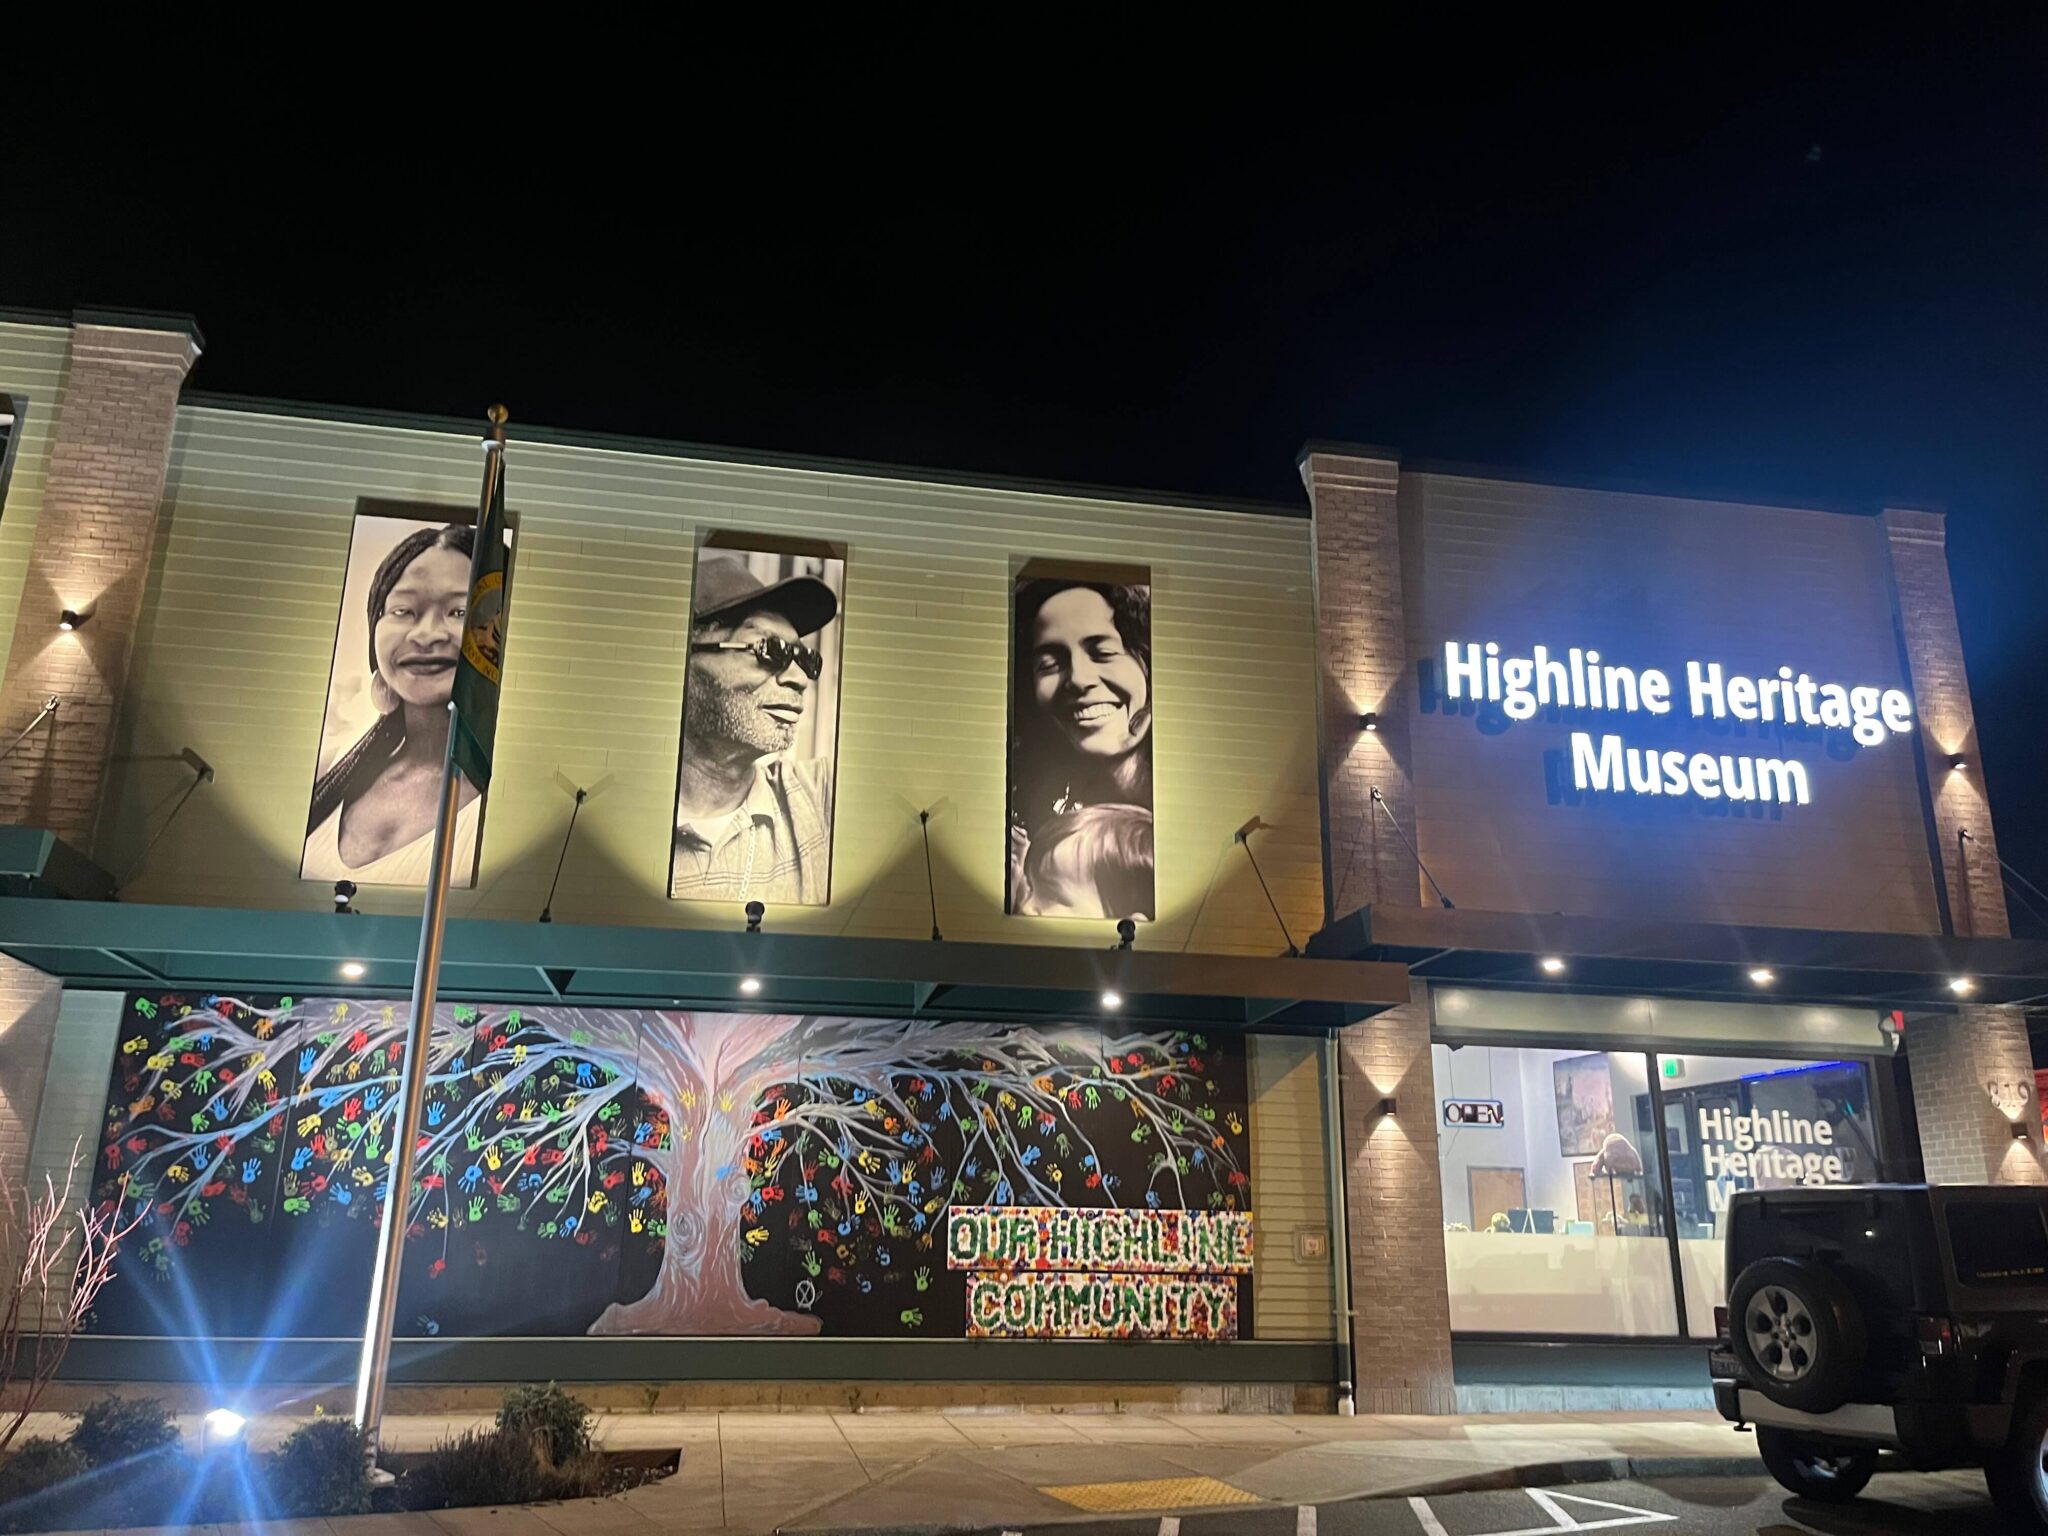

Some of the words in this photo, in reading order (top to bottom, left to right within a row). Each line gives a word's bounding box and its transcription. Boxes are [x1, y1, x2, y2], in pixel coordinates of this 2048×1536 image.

[1444, 640, 1671, 720] Highline
[1686, 660, 1914, 747] Heritage
[1571, 732, 1810, 805] Museum
[1445, 1103, 1503, 1124] OPEN
[1699, 1107, 1833, 1151] Highline
[1702, 1144, 1843, 1186] Heritage
[950, 1216, 1037, 1261] OUR
[1050, 1217, 1252, 1265] HIGHLINE
[971, 1280, 1225, 1332] COMMUNITY
